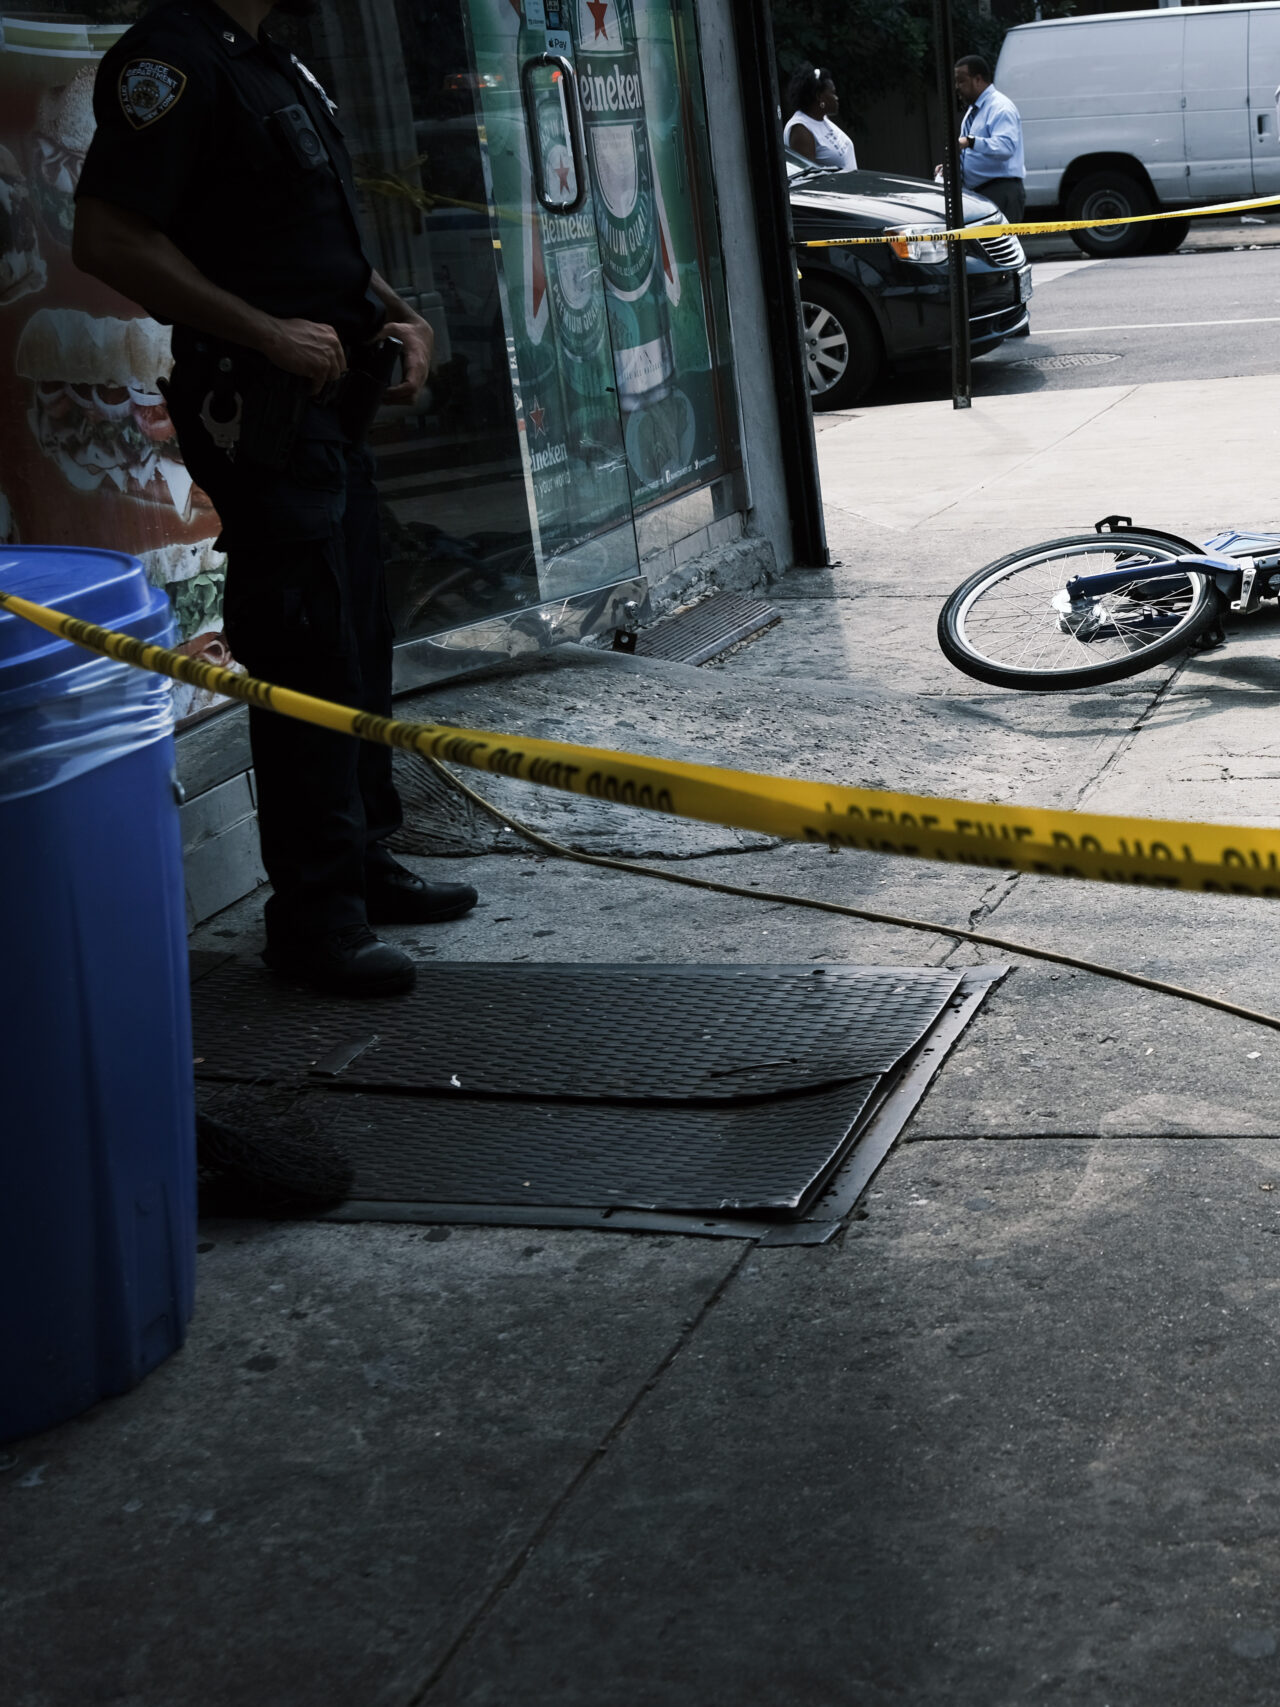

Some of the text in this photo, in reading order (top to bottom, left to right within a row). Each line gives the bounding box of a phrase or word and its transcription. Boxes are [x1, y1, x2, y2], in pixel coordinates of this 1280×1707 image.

[554, 38, 567, 50] Pay
[139, 62, 169, 75] POLICE
[541, 212, 597, 244] Heineken
